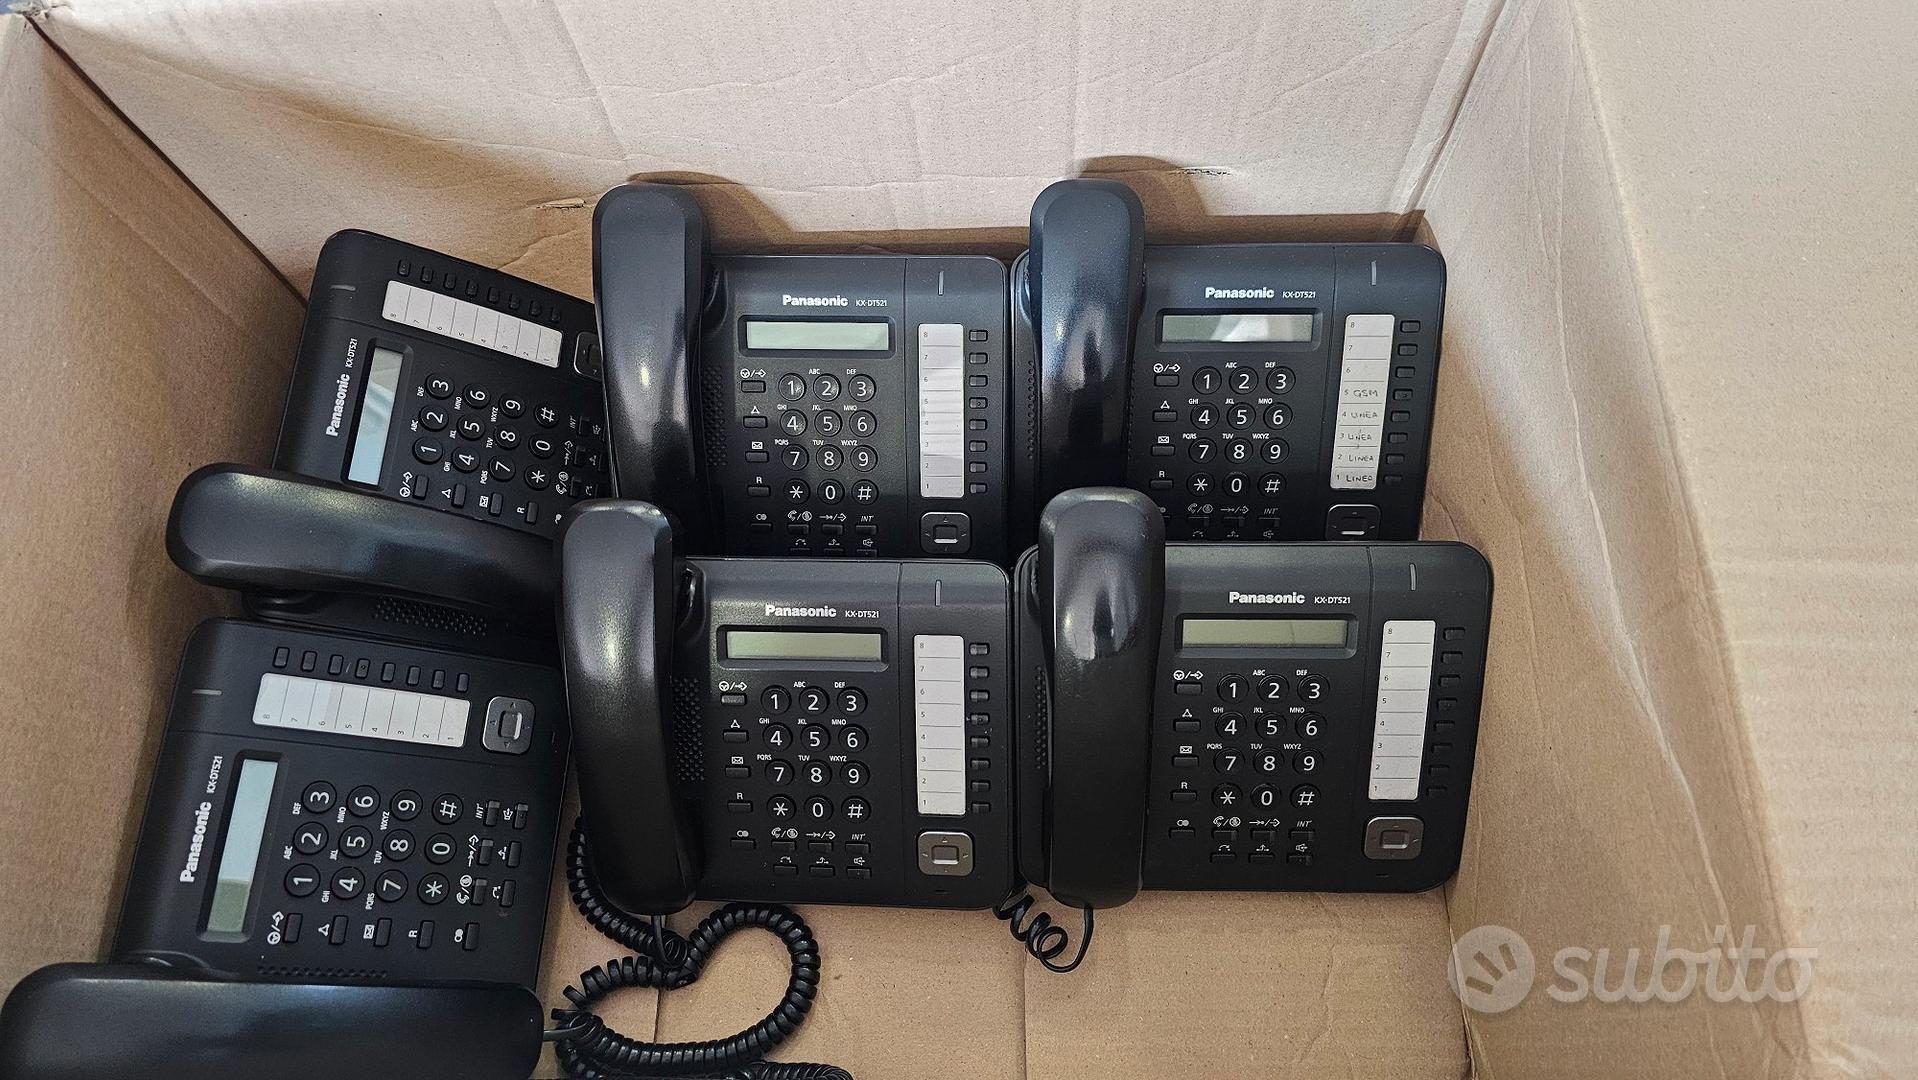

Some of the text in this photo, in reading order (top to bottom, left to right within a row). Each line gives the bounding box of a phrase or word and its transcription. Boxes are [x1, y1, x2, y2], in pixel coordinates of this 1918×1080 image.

[1205, 287, 1274, 299] Panasonic
[783, 295, 848, 307] Panasonic
[432, 380, 449, 391] 3
[788, 381, 794, 395] 1
[821, 381, 832, 395] 2
[1203, 375, 1210, 388] 1
[1238, 374, 1250, 389] 2
[1276, 374, 1286, 389] 3
[470, 391, 486, 400] 6
[856, 382, 866, 396] 3
[1353, 389, 1378, 398] GSM
[326, 374, 350, 436] Panasonic
[506, 400, 520, 410] 9
[427, 412, 443, 424] 2
[787, 416, 798, 430] 4
[1199, 409, 1210, 424] 4
[1237, 410, 1246, 424] 5
[1273, 410, 1283, 424] 6
[464, 422, 480, 432] 5
[824, 417, 832, 431] 5
[857, 417, 867, 431] 6
[501, 430, 516, 441] 8
[421, 445, 437, 453] 1
[536, 440, 550, 450] 0
[1199, 445, 1209, 459] 7
[1234, 444, 1244, 459] 8
[1270, 445, 1280, 459] 9
[459, 455, 474, 465] 4
[790, 452, 800, 466] 7
[824, 452, 834, 466] 8
[859, 452, 868, 467] 9
[1349, 454, 1374, 462] LINEA
[496, 462, 510, 473] 7
[1231, 478, 1241, 492] 0
[826, 486, 835, 500] 0
[1229, 592, 1305, 604] Panasonic
[765, 605, 836, 618] Panasonic
[1230, 683, 1236, 697] 1
[1269, 683, 1280, 698] 2
[1309, 683, 1320, 698] 3
[771, 695, 778, 709] 1
[808, 695, 819, 710] 2
[846, 696, 856, 711] 3
[1225, 720, 1237, 734] 4
[1267, 720, 1277, 734] 5
[1306, 720, 1317, 734] 6
[770, 731, 782, 746] 4
[810, 732, 819, 746] 5
[847, 732, 858, 747] 6
[1225, 756, 1236, 770] 7
[1264, 756, 1275, 770] 8
[1304, 756, 1314, 771] 9
[774, 768, 784, 781] 7
[811, 768, 822, 782] 8
[848, 768, 859, 783] 9
[310, 792, 329, 804] 3
[355, 796, 373, 807] 6
[1261, 791, 1272, 805] 0
[399, 800, 416, 811] 9
[813, 804, 823, 817] 0
[337, 807, 346, 822] MNO
[381, 812, 389, 830] WXYZ
[180, 802, 211, 882] Panasonic
[301, 832, 321, 845] 2
[347, 837, 365, 847] 5
[391, 839, 408, 851] 8
[284, 846, 293, 860] ABC
[432, 842, 450, 854] 0
[374, 851, 382, 863] TUV
[293, 877, 313, 885] 1
[339, 879, 357, 891] 4
[383, 880, 400, 891] 7
[366, 893, 374, 909] PQRS
